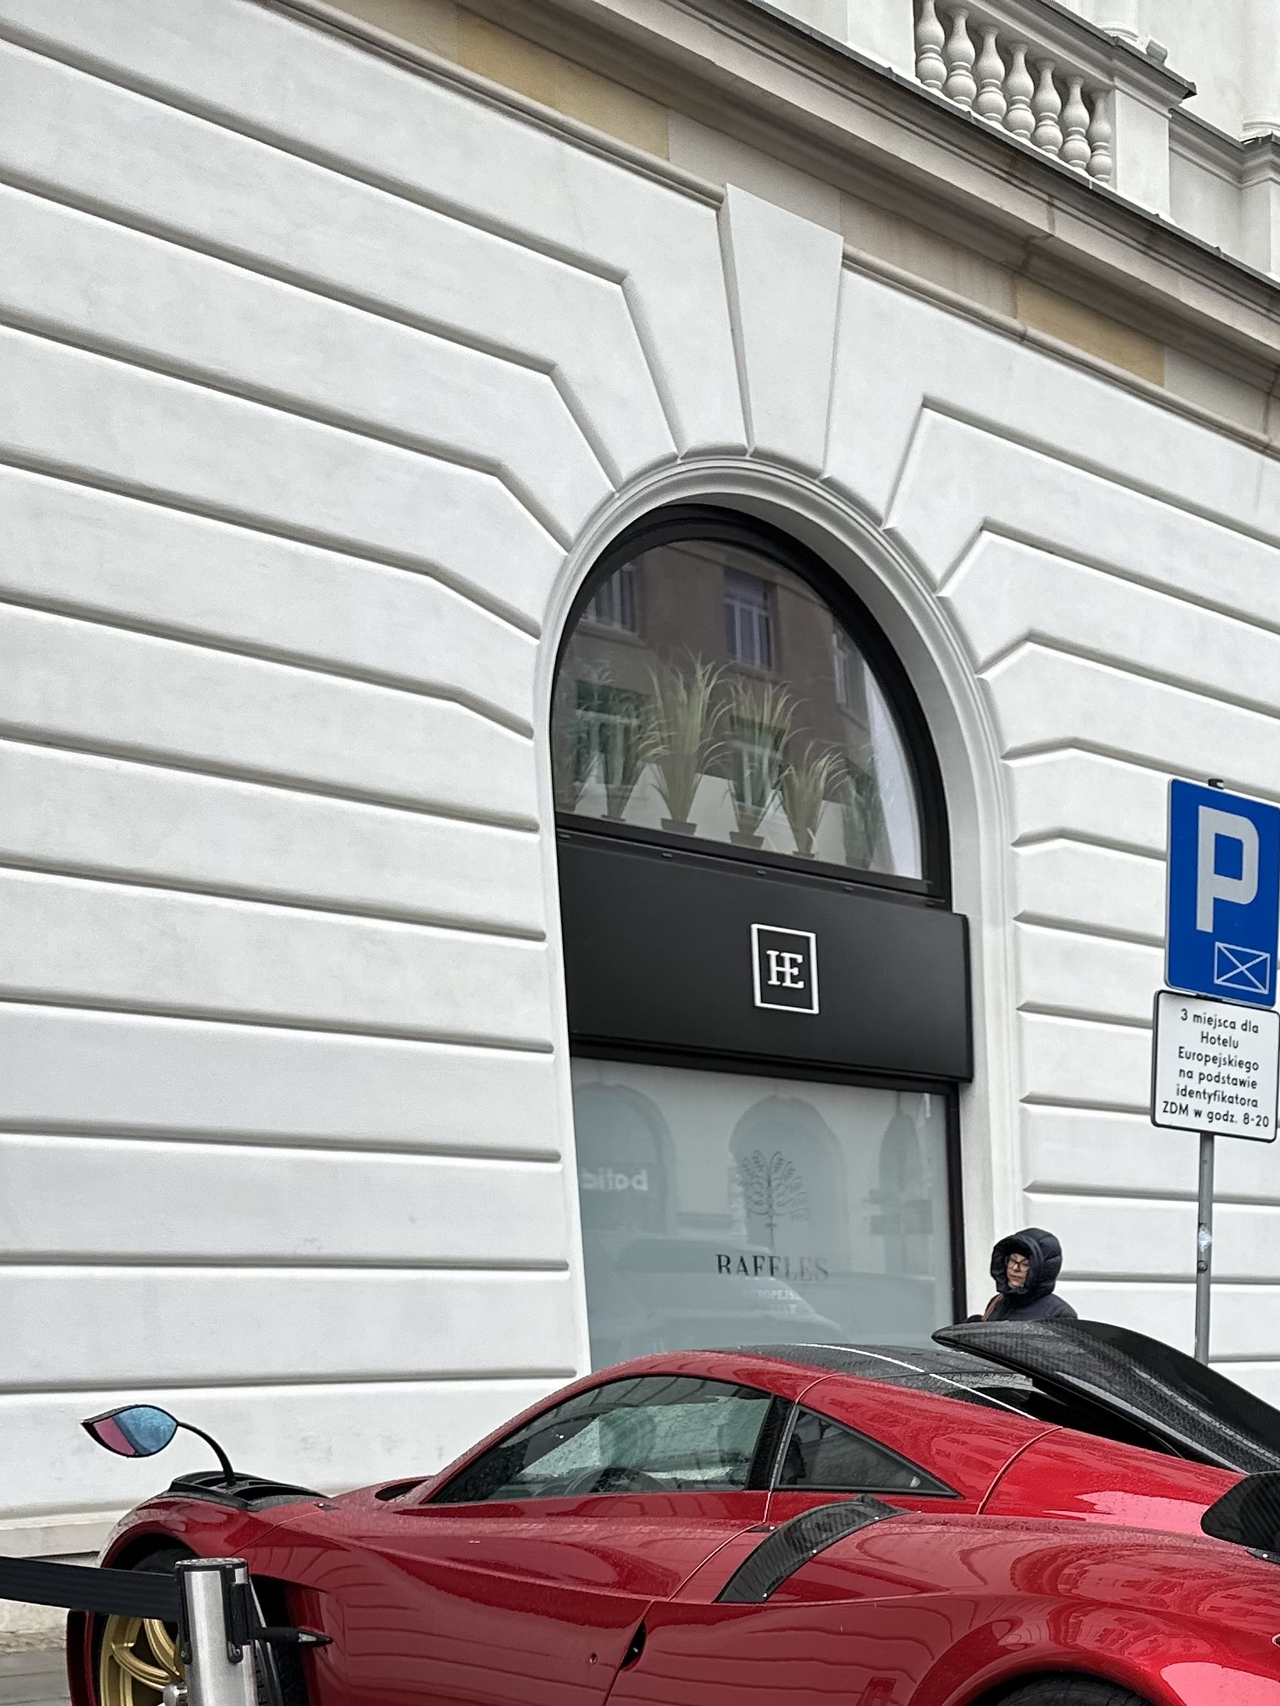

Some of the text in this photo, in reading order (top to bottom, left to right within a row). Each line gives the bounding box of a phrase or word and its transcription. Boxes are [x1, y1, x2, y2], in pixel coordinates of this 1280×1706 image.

[1196, 805, 1260, 933] P
[1180, 1008, 1259, 1034] 3 miejsca dla
[1200, 1031, 1239, 1049] Hotelu
[1178, 1046, 1260, 1073] Europejskiego
[1178, 1068, 1258, 1090] na podstawie
[1176, 1083, 1259, 1108] identyfikatora
[1162, 1101, 1270, 1128] ZDM w godz. 8-20
[716, 1253, 829, 1283] RAFFLES
